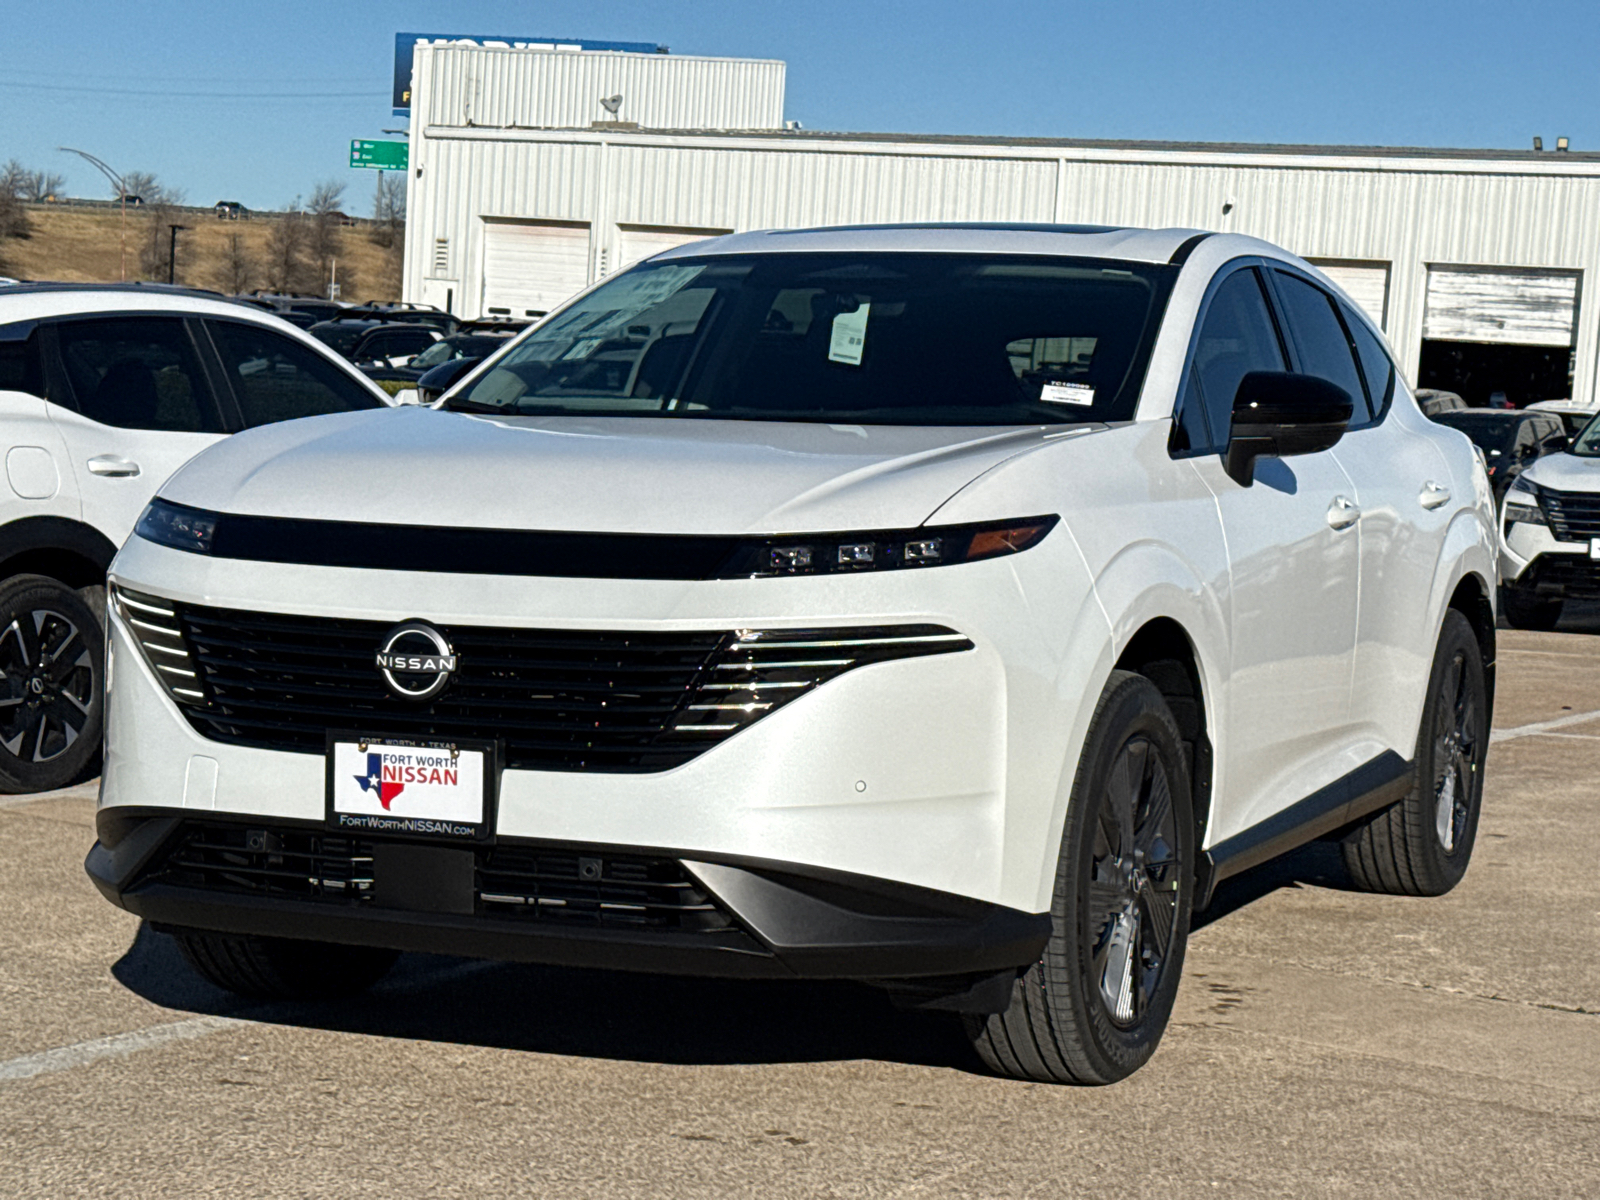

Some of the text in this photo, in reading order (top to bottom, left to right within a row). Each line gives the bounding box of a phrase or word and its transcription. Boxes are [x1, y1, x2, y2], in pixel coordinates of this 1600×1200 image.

[376, 654, 454, 670] NISSAN
[385, 739, 416, 747] WORTH
[428, 741, 457, 749] TEXAS
[383, 753, 458, 768] FORT WORTH
[383, 765, 458, 785] NISSAN
